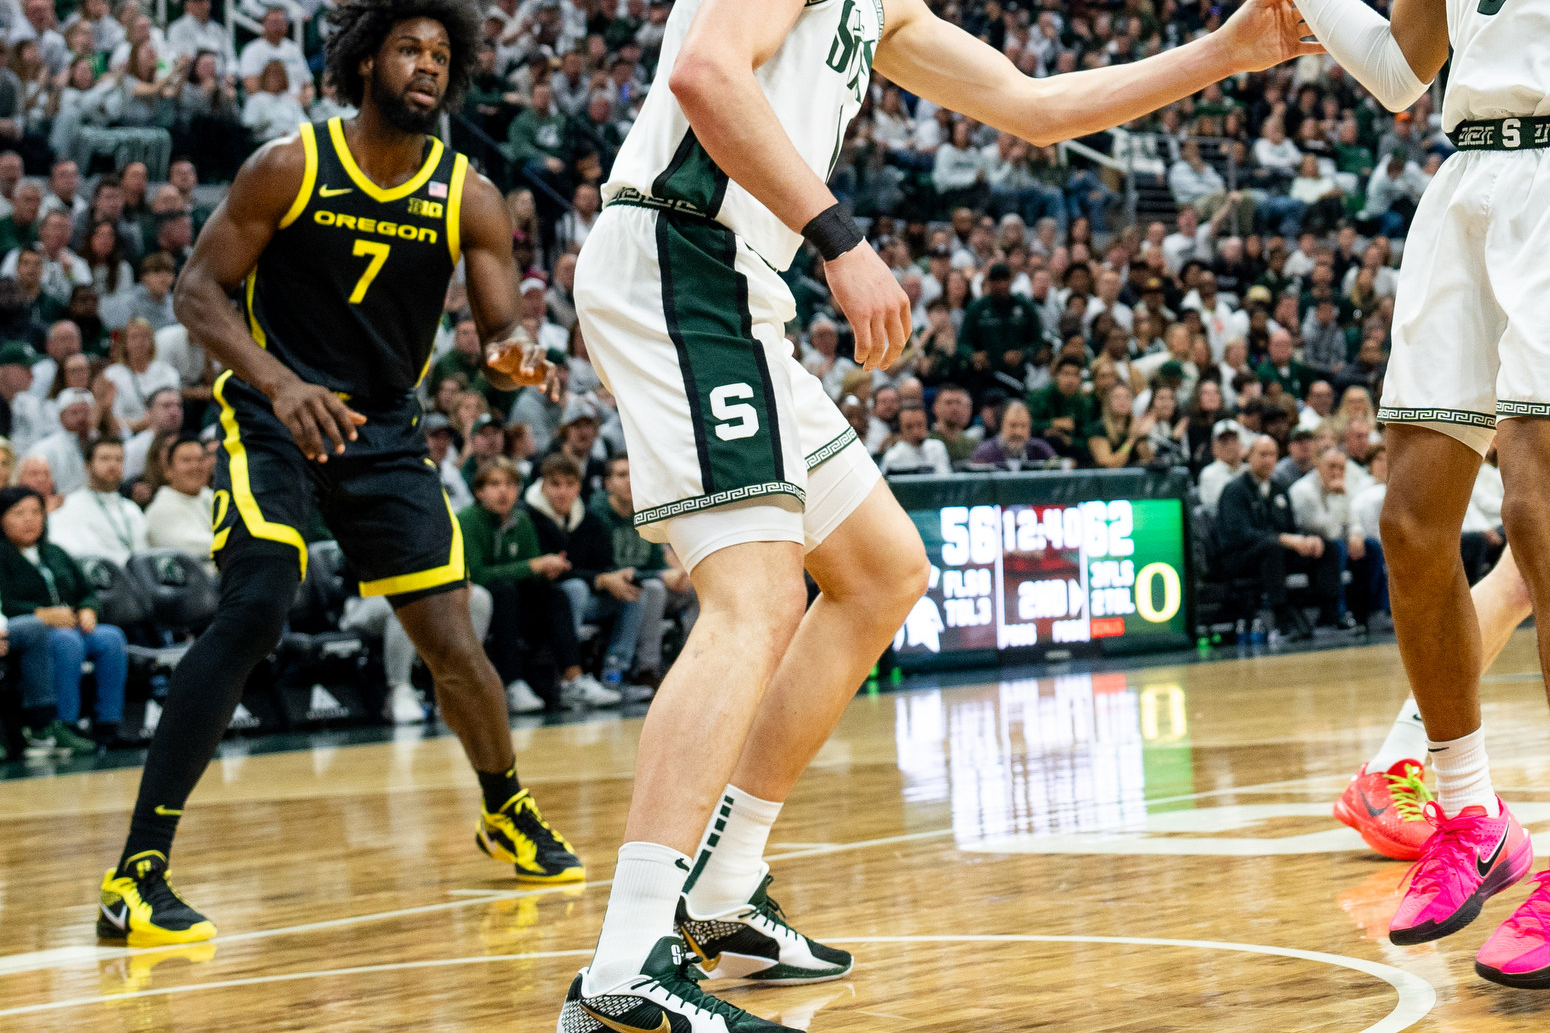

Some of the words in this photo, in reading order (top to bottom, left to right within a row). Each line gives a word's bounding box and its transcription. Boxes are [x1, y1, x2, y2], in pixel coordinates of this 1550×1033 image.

[1501, 118, 1521, 148] S
[314, 211, 437, 244] OREGON
[349, 239, 391, 304] 7
[709, 382, 759, 441] S
[940, 505, 997, 566] 56
[1084, 500, 1135, 557] 62
